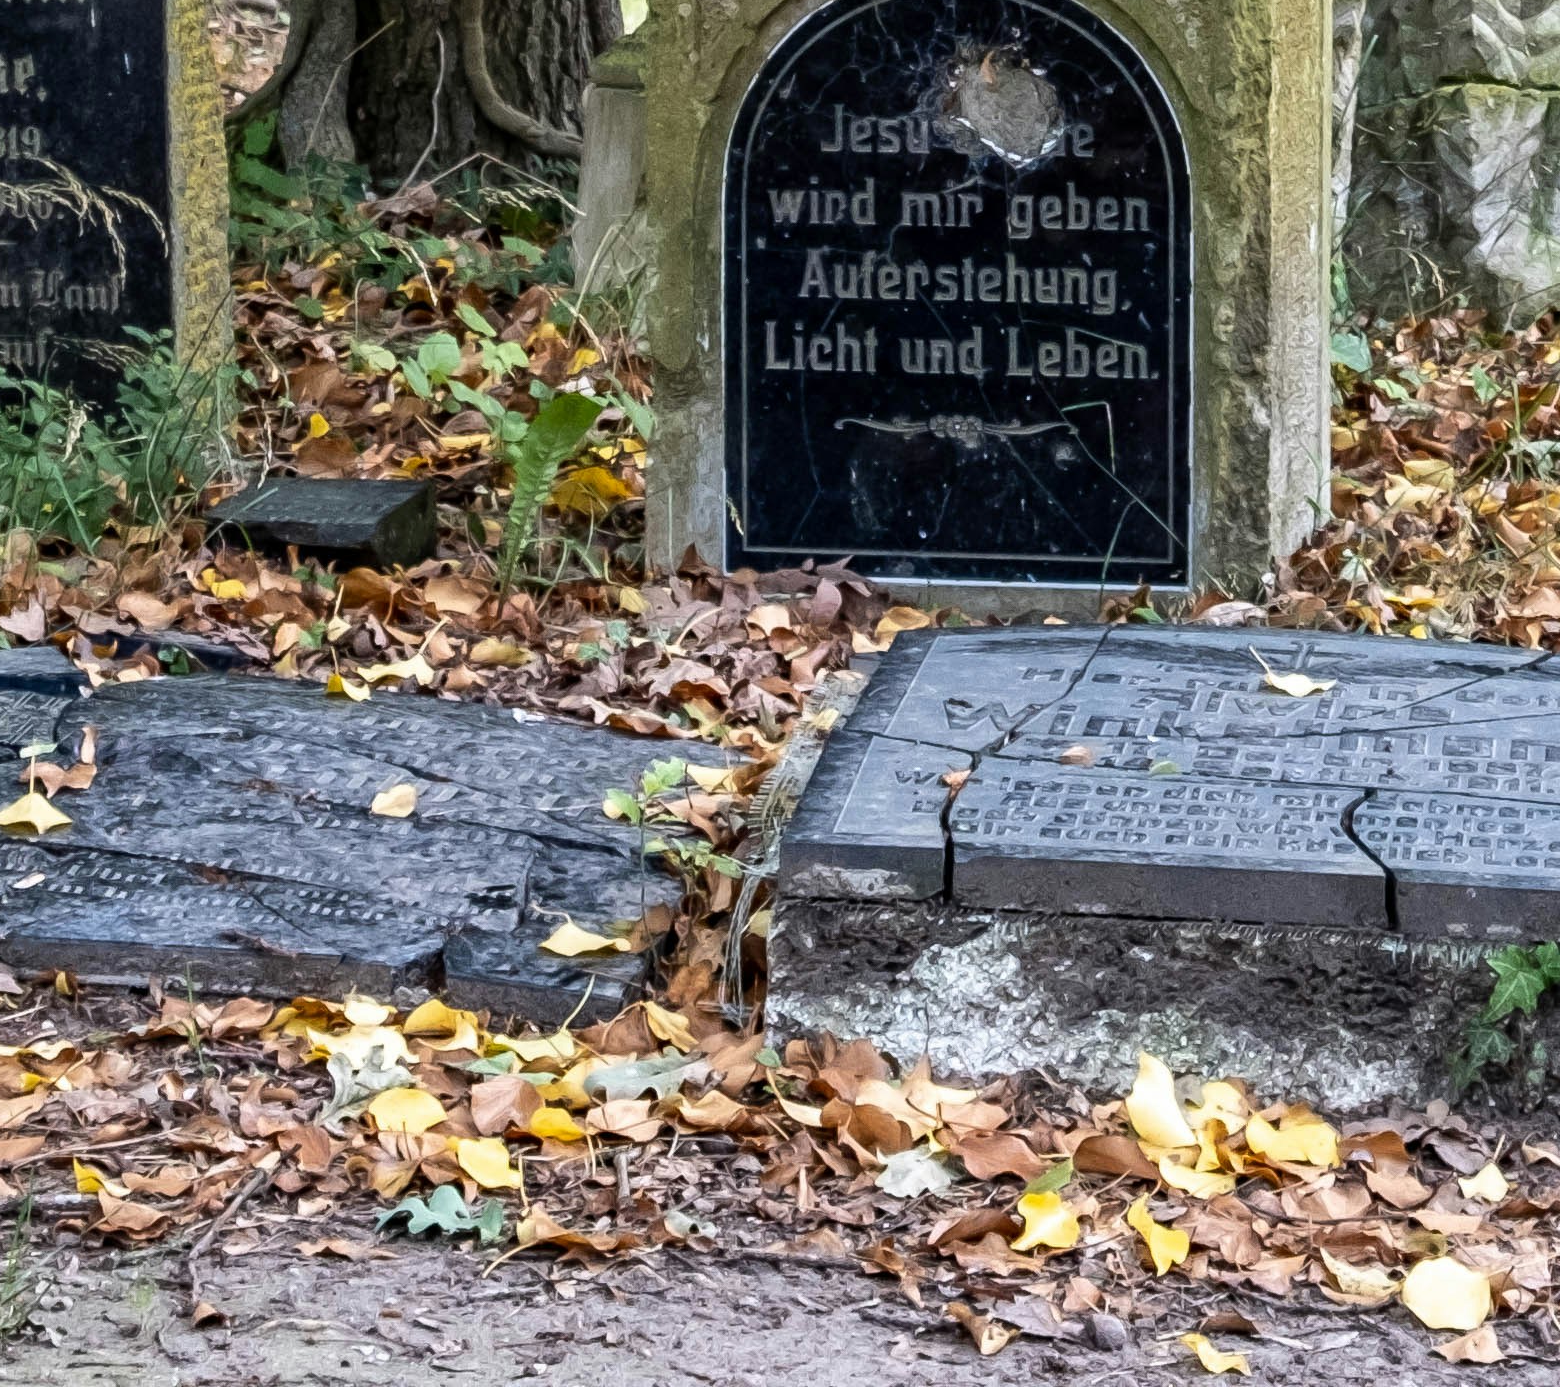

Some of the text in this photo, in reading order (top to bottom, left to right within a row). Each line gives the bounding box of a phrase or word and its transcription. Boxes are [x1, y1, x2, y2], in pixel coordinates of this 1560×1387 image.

[767, 176, 1151, 240] wird mir geben
[763, 320, 1160, 379] Licht und Leben.
